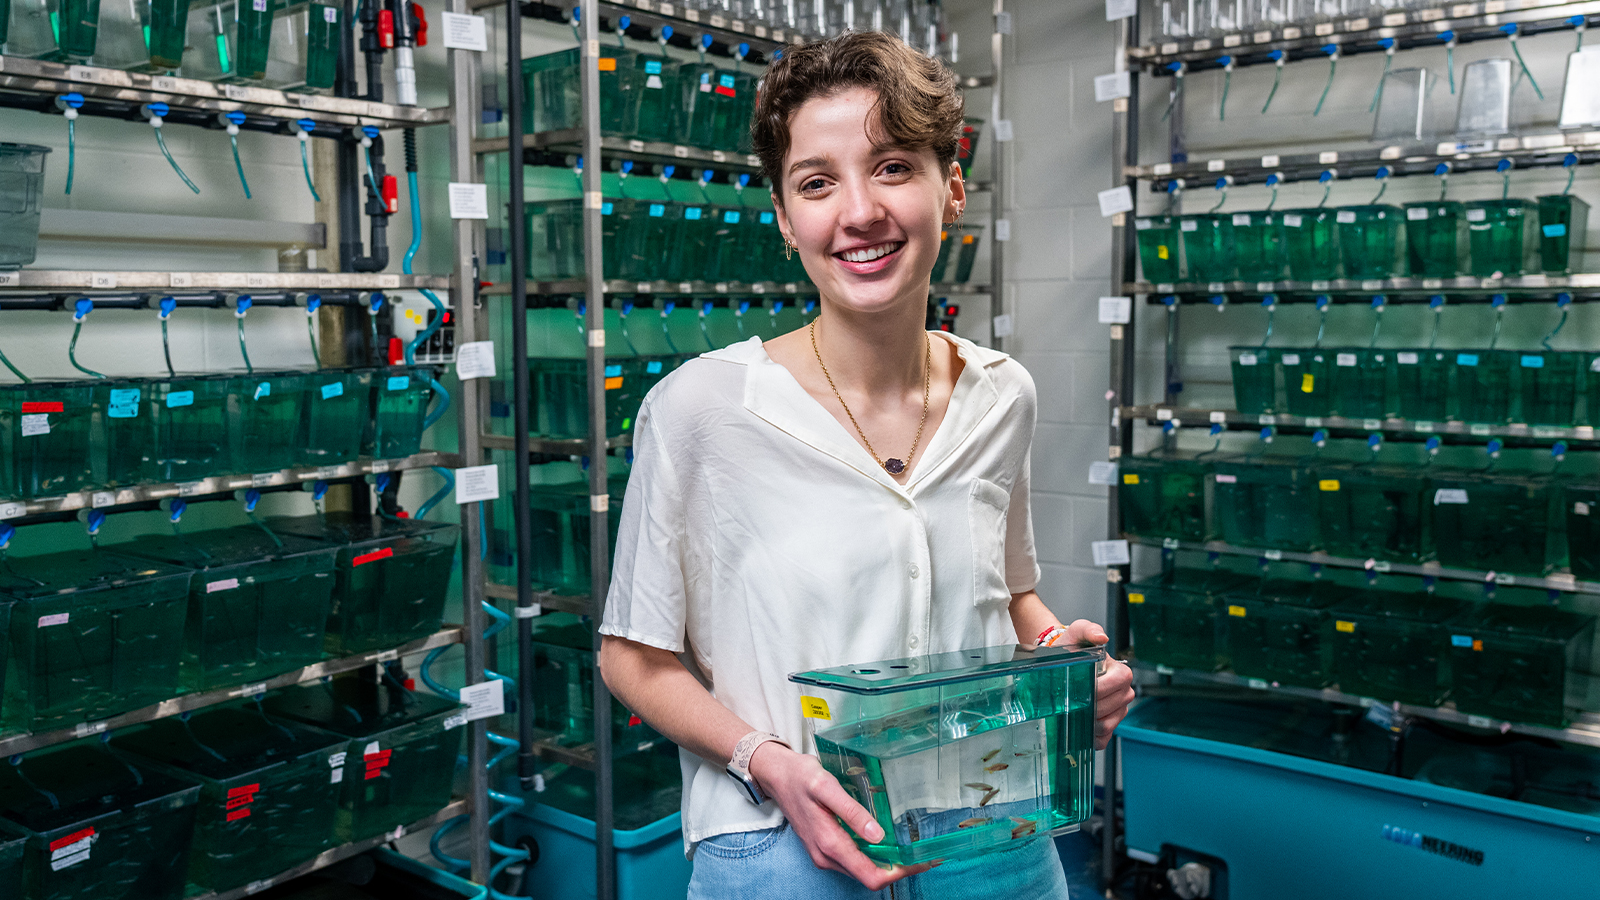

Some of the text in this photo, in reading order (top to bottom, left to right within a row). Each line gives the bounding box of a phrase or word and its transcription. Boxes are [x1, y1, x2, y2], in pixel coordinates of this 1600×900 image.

[0, 276, 10, 284] D7
[98, 276, 109, 285] D8
[173, 276, 185, 285] D9
[5, 506, 18, 516] C7
